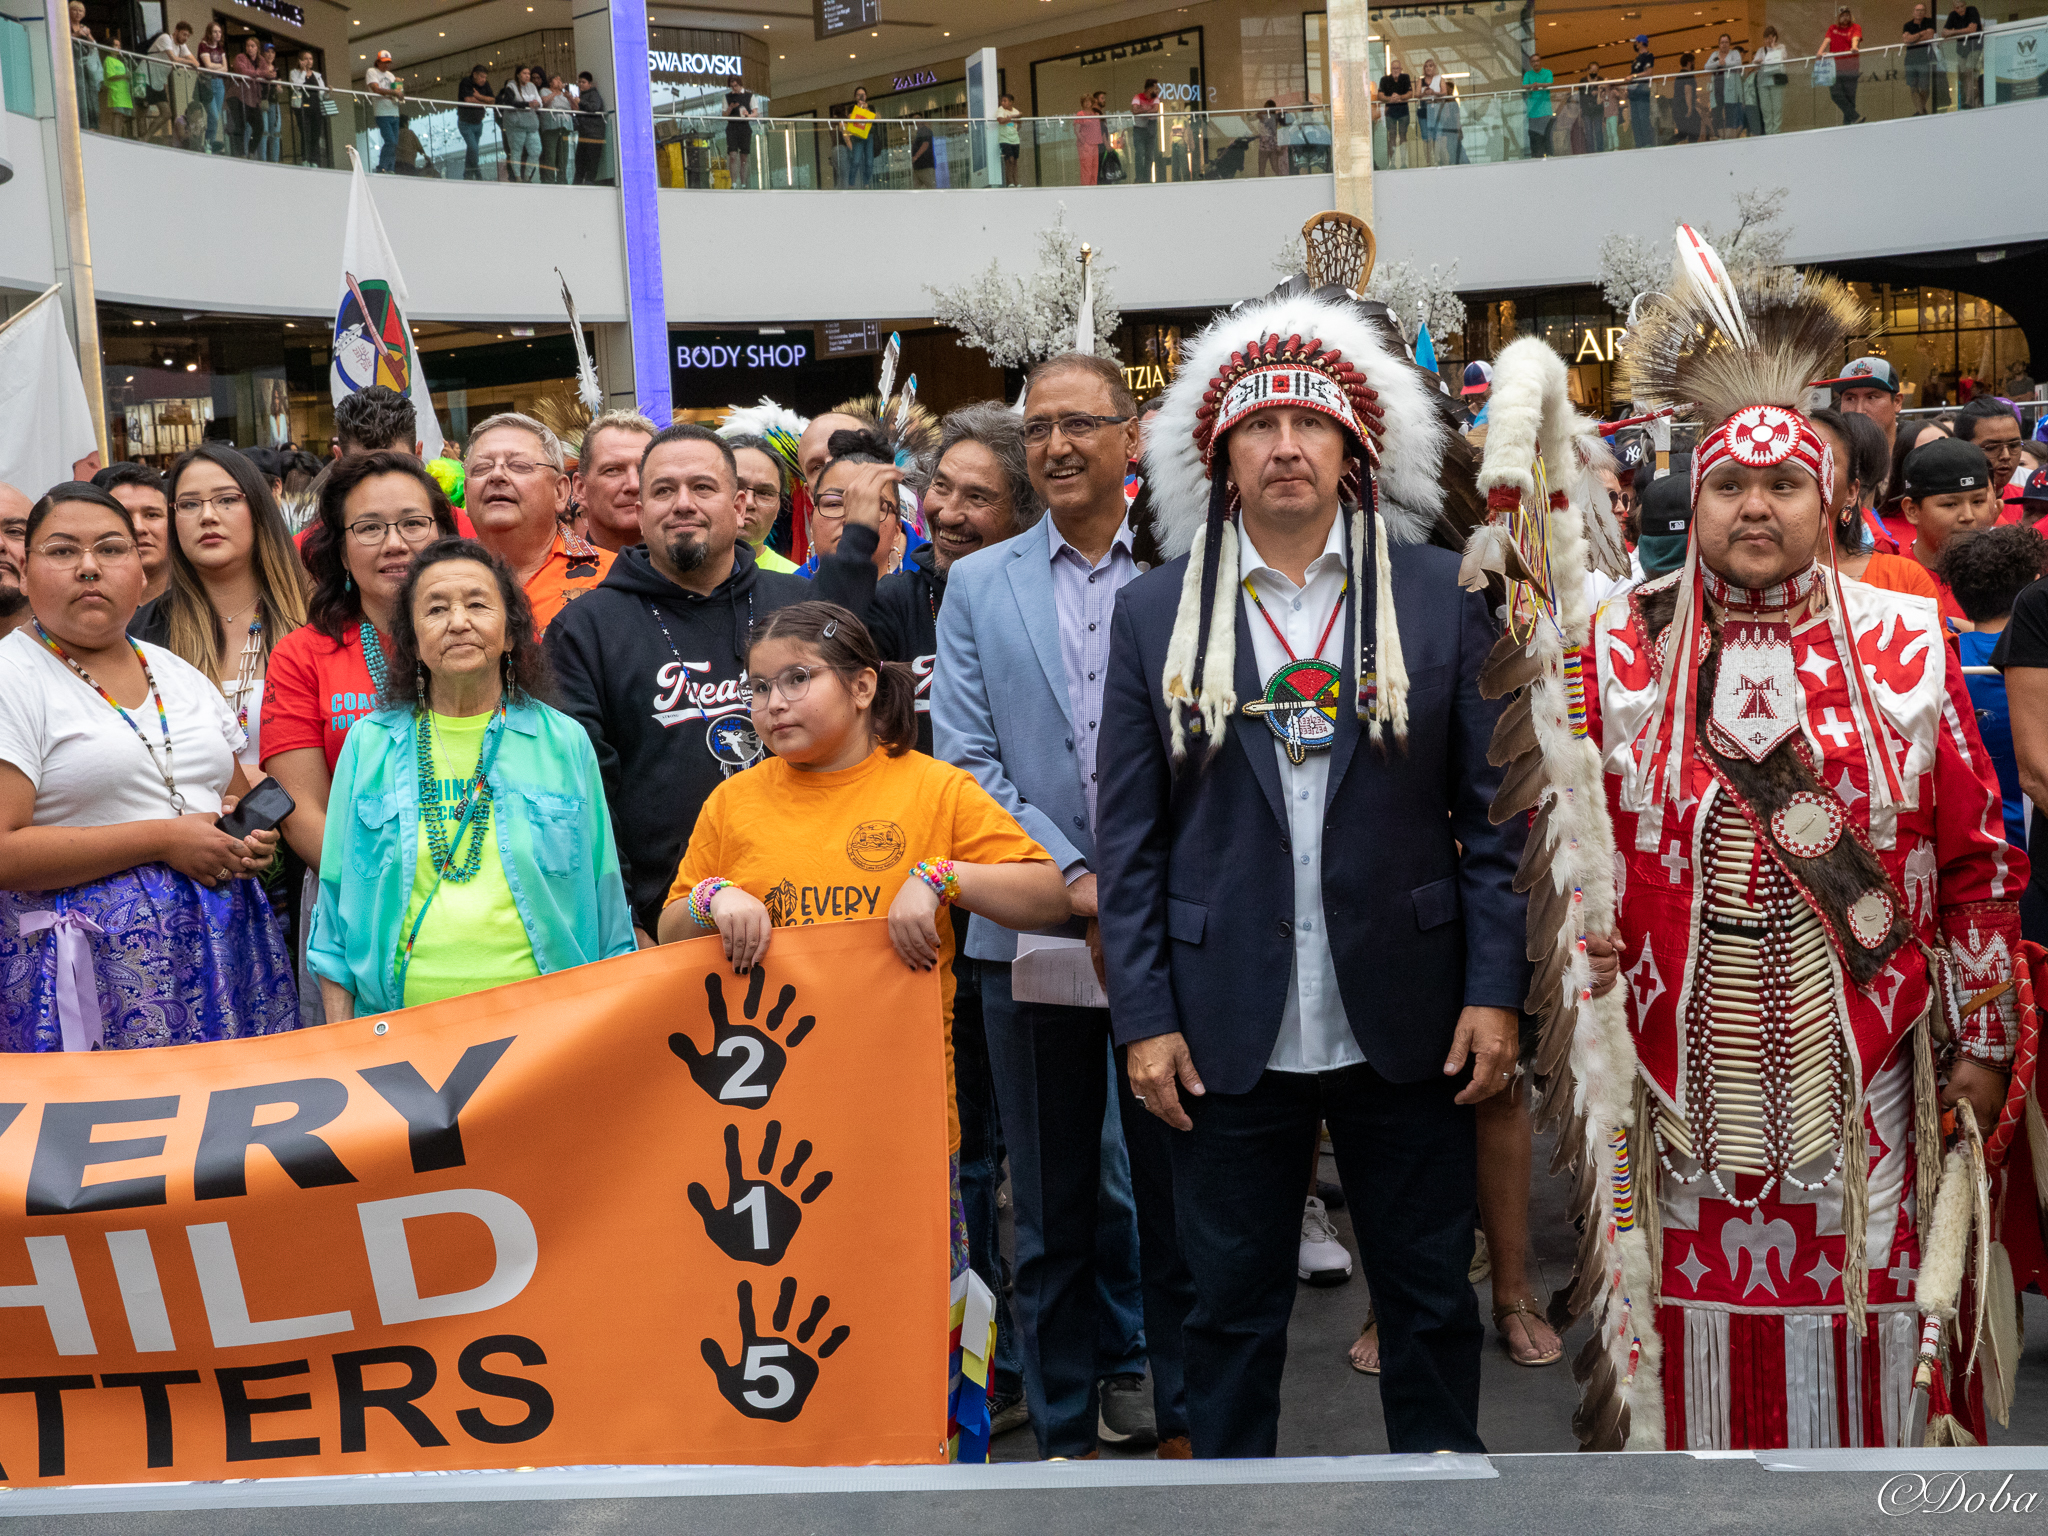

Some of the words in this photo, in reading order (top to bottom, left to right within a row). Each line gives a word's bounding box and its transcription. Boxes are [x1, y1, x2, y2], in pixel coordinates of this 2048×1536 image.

[648, 50, 742, 76] SWAROVSKI
[893, 71, 937, 90] ZARA
[677, 345, 741, 368] BODY
[747, 345, 806, 367] SHOP
[801, 885, 880, 916] EVERY
[717, 1036, 768, 1100] 2
[0, 1036, 517, 1216] ERY
[733, 1186, 770, 1250] 1
[0, 1335, 555, 1481] TTERS
[743, 1345, 795, 1409] 5
